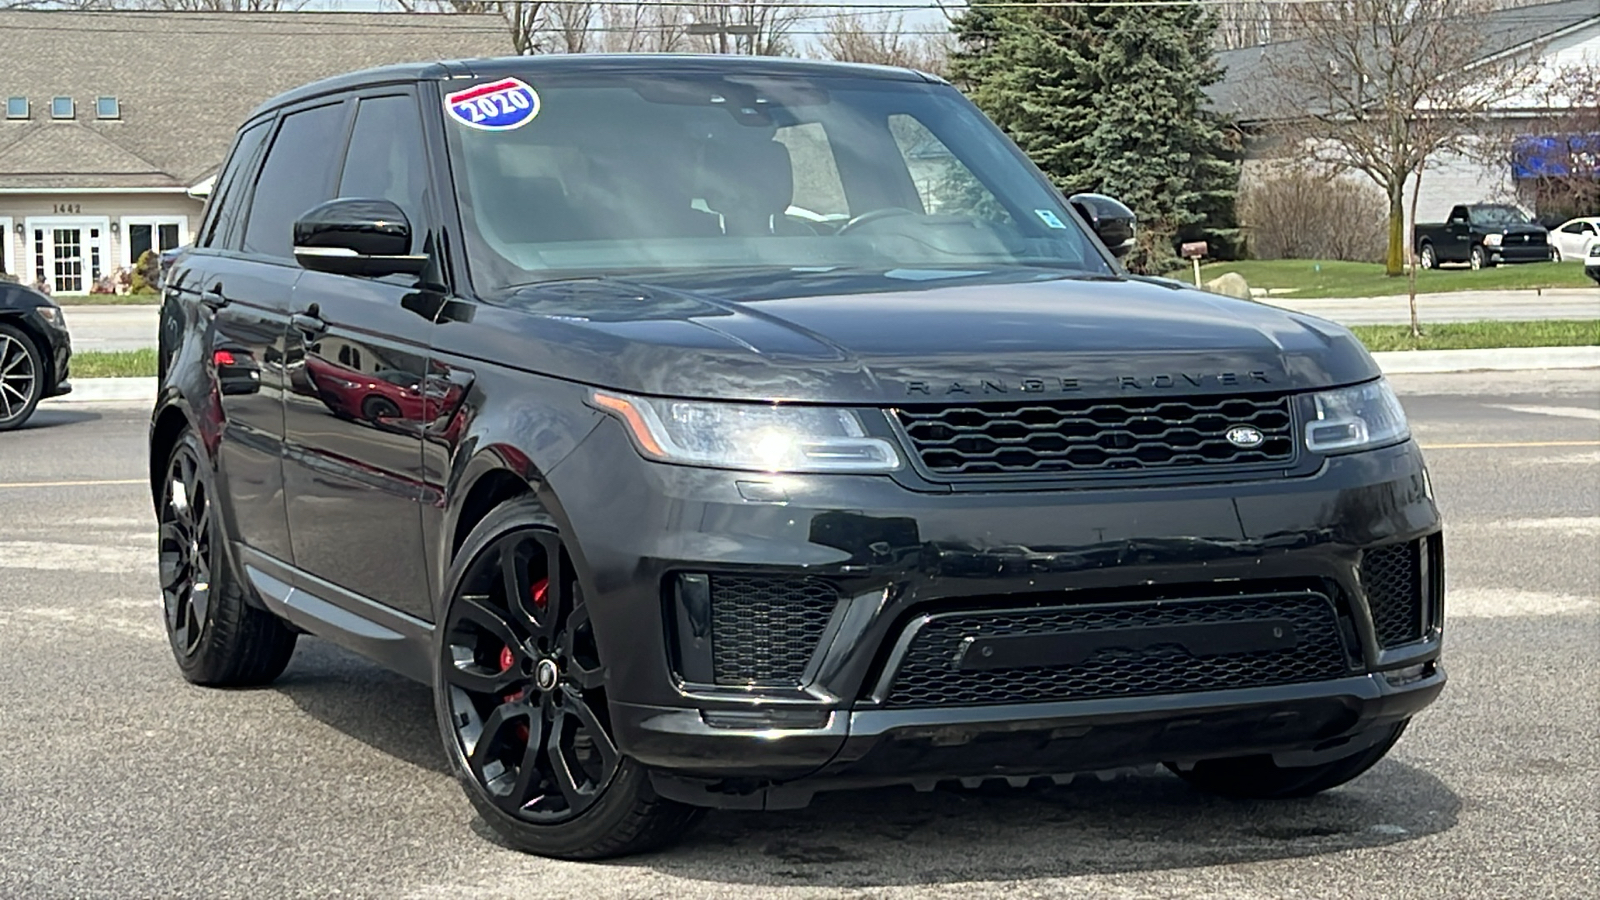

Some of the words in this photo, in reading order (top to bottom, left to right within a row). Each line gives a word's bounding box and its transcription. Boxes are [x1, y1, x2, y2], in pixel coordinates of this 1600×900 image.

[460, 90, 530, 123] 2020
[53, 203, 81, 214] 1442
[905, 377, 1082, 396] RANGE
[1116, 371, 1271, 390] ROVER
